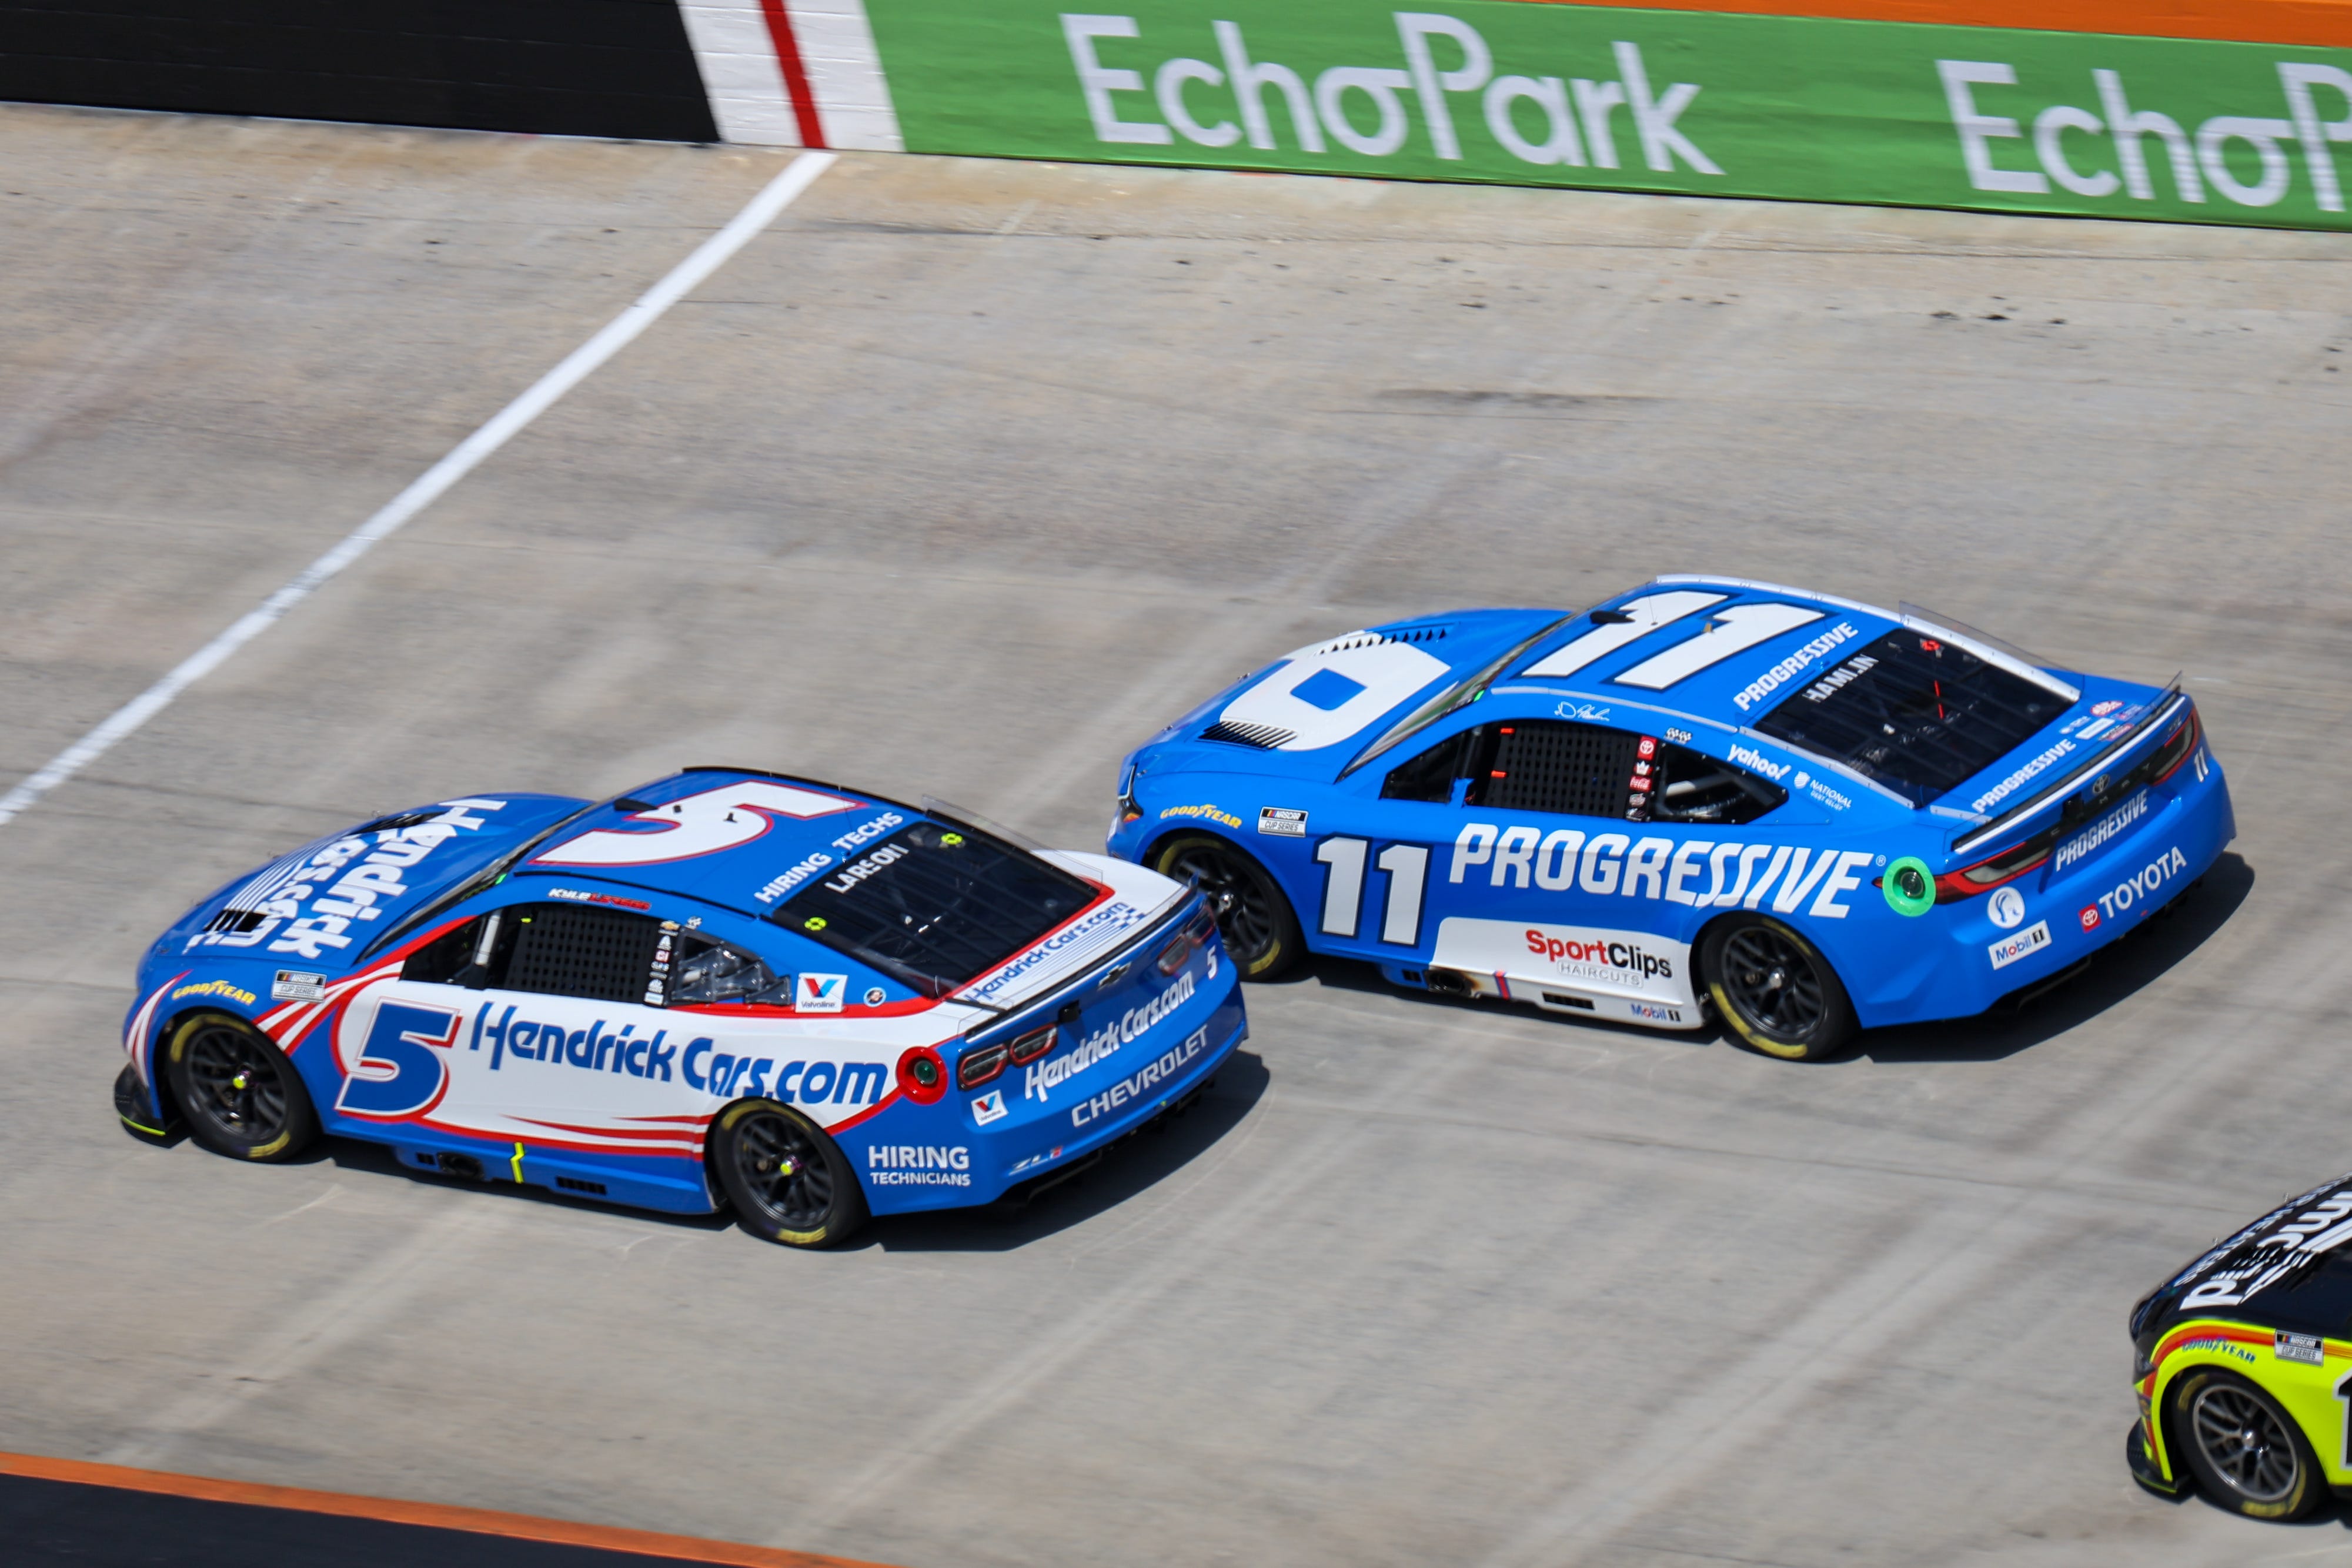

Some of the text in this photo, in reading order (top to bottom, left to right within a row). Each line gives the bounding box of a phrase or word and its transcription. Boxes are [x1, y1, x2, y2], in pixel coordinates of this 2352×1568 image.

[1058, 11, 1726, 175] EchoPark
[1520, 589, 1826, 690] 11
[1733, 621, 1859, 711] PROGRESSIVE
[1802, 653, 1879, 703] HAMLIN
[1727, 743, 1792, 781] yahoo!
[1972, 738, 2076, 813] PROGRESSIVE
[2193, 747, 2209, 783] 11
[1810, 779, 1852, 808] NATIONAL
[528, 779, 869, 867] 5
[1160, 804, 1242, 829] GOODYEAR
[1265, 820, 1298, 831] CUP SERIES
[1275, 810, 1301, 820] NASCAR
[2056, 789, 2147, 871] PROGRESSIVE
[754, 812, 903, 904] HIRING TECHS
[1449, 823, 1873, 919] PROGRESSIVE
[1317, 836, 1428, 945] 11
[2099, 846, 2187, 918] TOYOTA
[1207, 945, 1217, 979] 5
[1996, 935, 2032, 961] Mobil
[172, 979, 256, 1006] GOODYEAR
[280, 984, 318, 996] CUP SERIES
[1560, 962, 1641, 985] HAIRCUTS
[1631, 1004, 1666, 1021] Mobil
[335, 998, 462, 1122] 5
[1072, 1024, 1207, 1128] CHEVROLET
[868, 1145, 970, 1170] HIRING
[870, 1172, 971, 1186] TECHNICIANS
